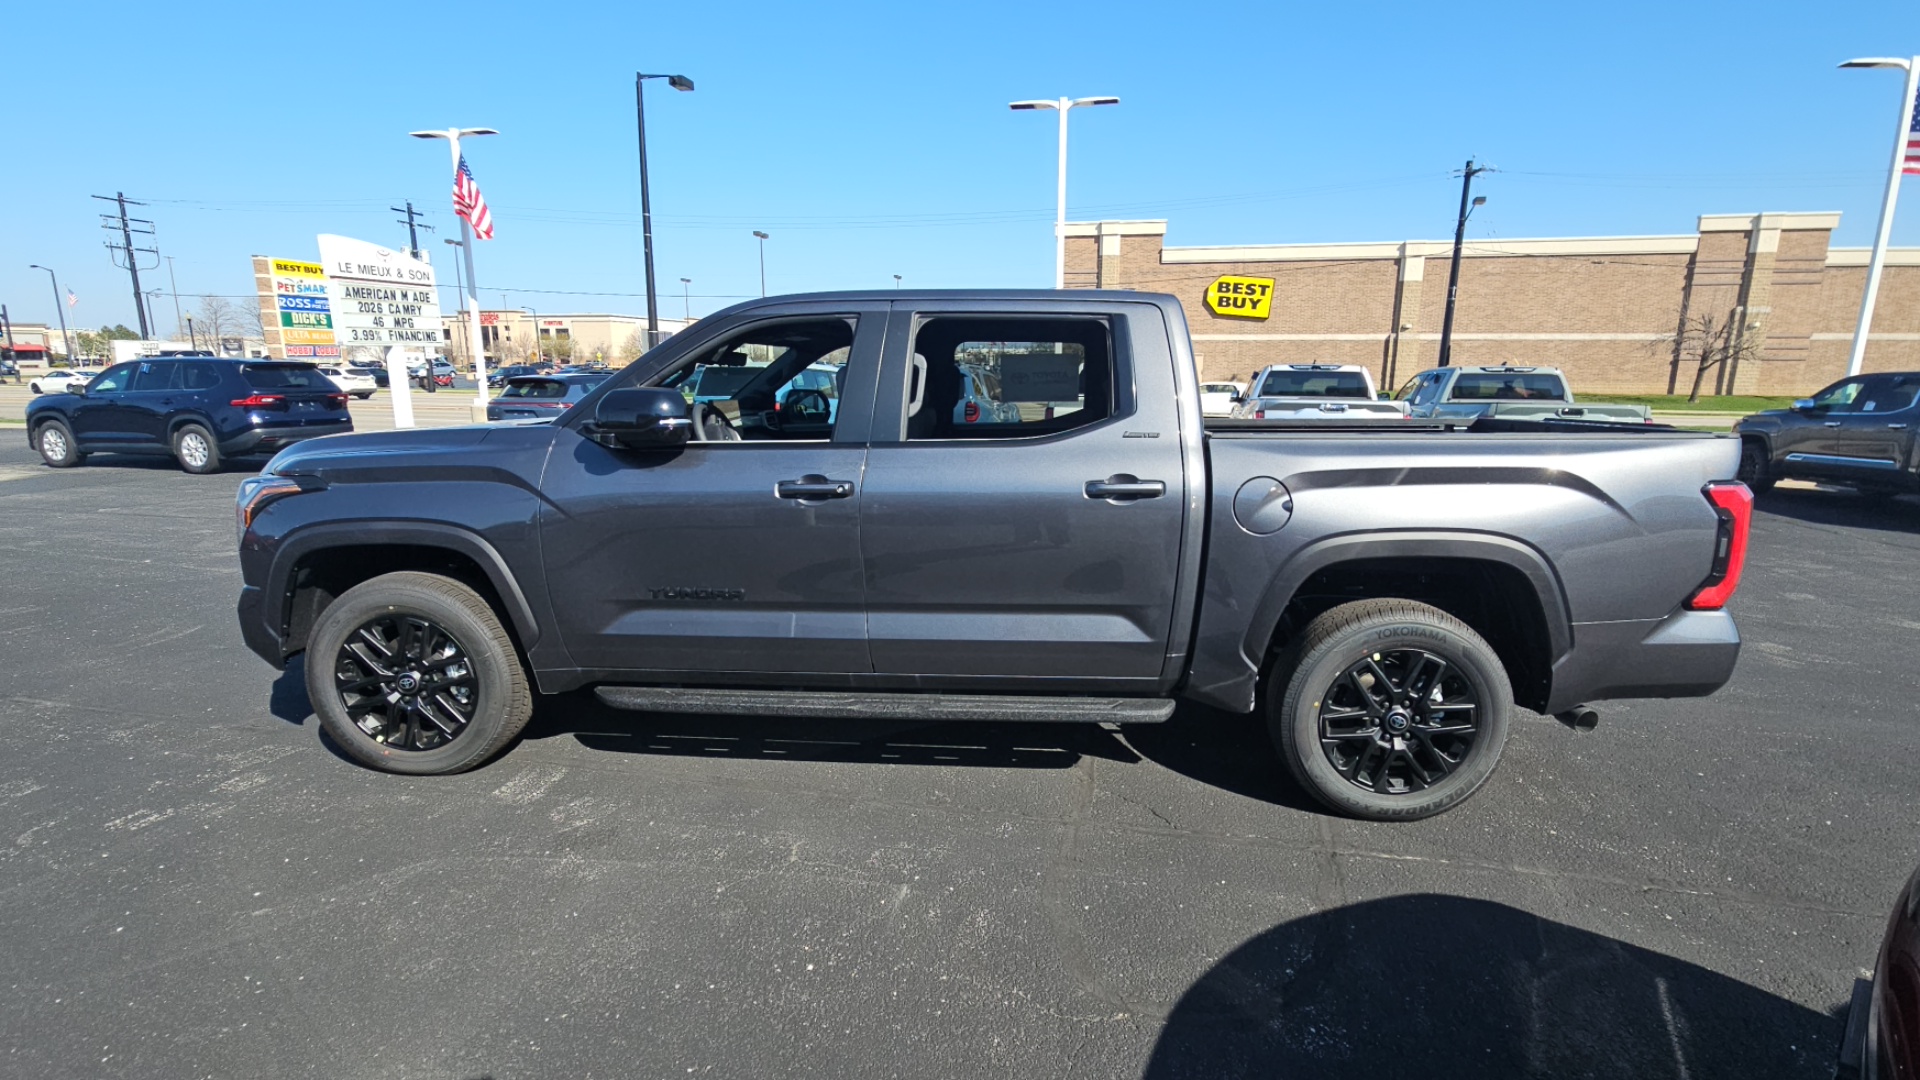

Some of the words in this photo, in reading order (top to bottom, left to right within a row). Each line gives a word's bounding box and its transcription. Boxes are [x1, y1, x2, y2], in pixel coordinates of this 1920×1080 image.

[276, 262, 302, 273] BEST
[302, 266, 324, 275] BUY
[338, 262, 353, 274] LE
[358, 264, 392, 278] MIEUX
[396, 268, 404, 278] &
[408, 268, 430, 281] SON
[344, 286, 396, 302] AMERICAN
[1216, 281, 1270, 296] BEST
[278, 297, 312, 308] ROSS
[358, 301, 384, 314] 2026
[388, 304, 422, 316] CAMRY
[1216, 296, 1263, 310] BUY
[292, 312, 328, 326] DICK'S
[372, 316, 384, 328] 46
[394, 317, 414, 328] MPG
[351, 329, 383, 342] 3.99%
[388, 330, 437, 342] FINANCING
[286, 346, 314, 356] HOBBY
[316, 346, 340, 356] LOBBY
[648, 587, 745, 599] TUNDRA
[1374, 626, 1448, 644] YOKOHAMA
